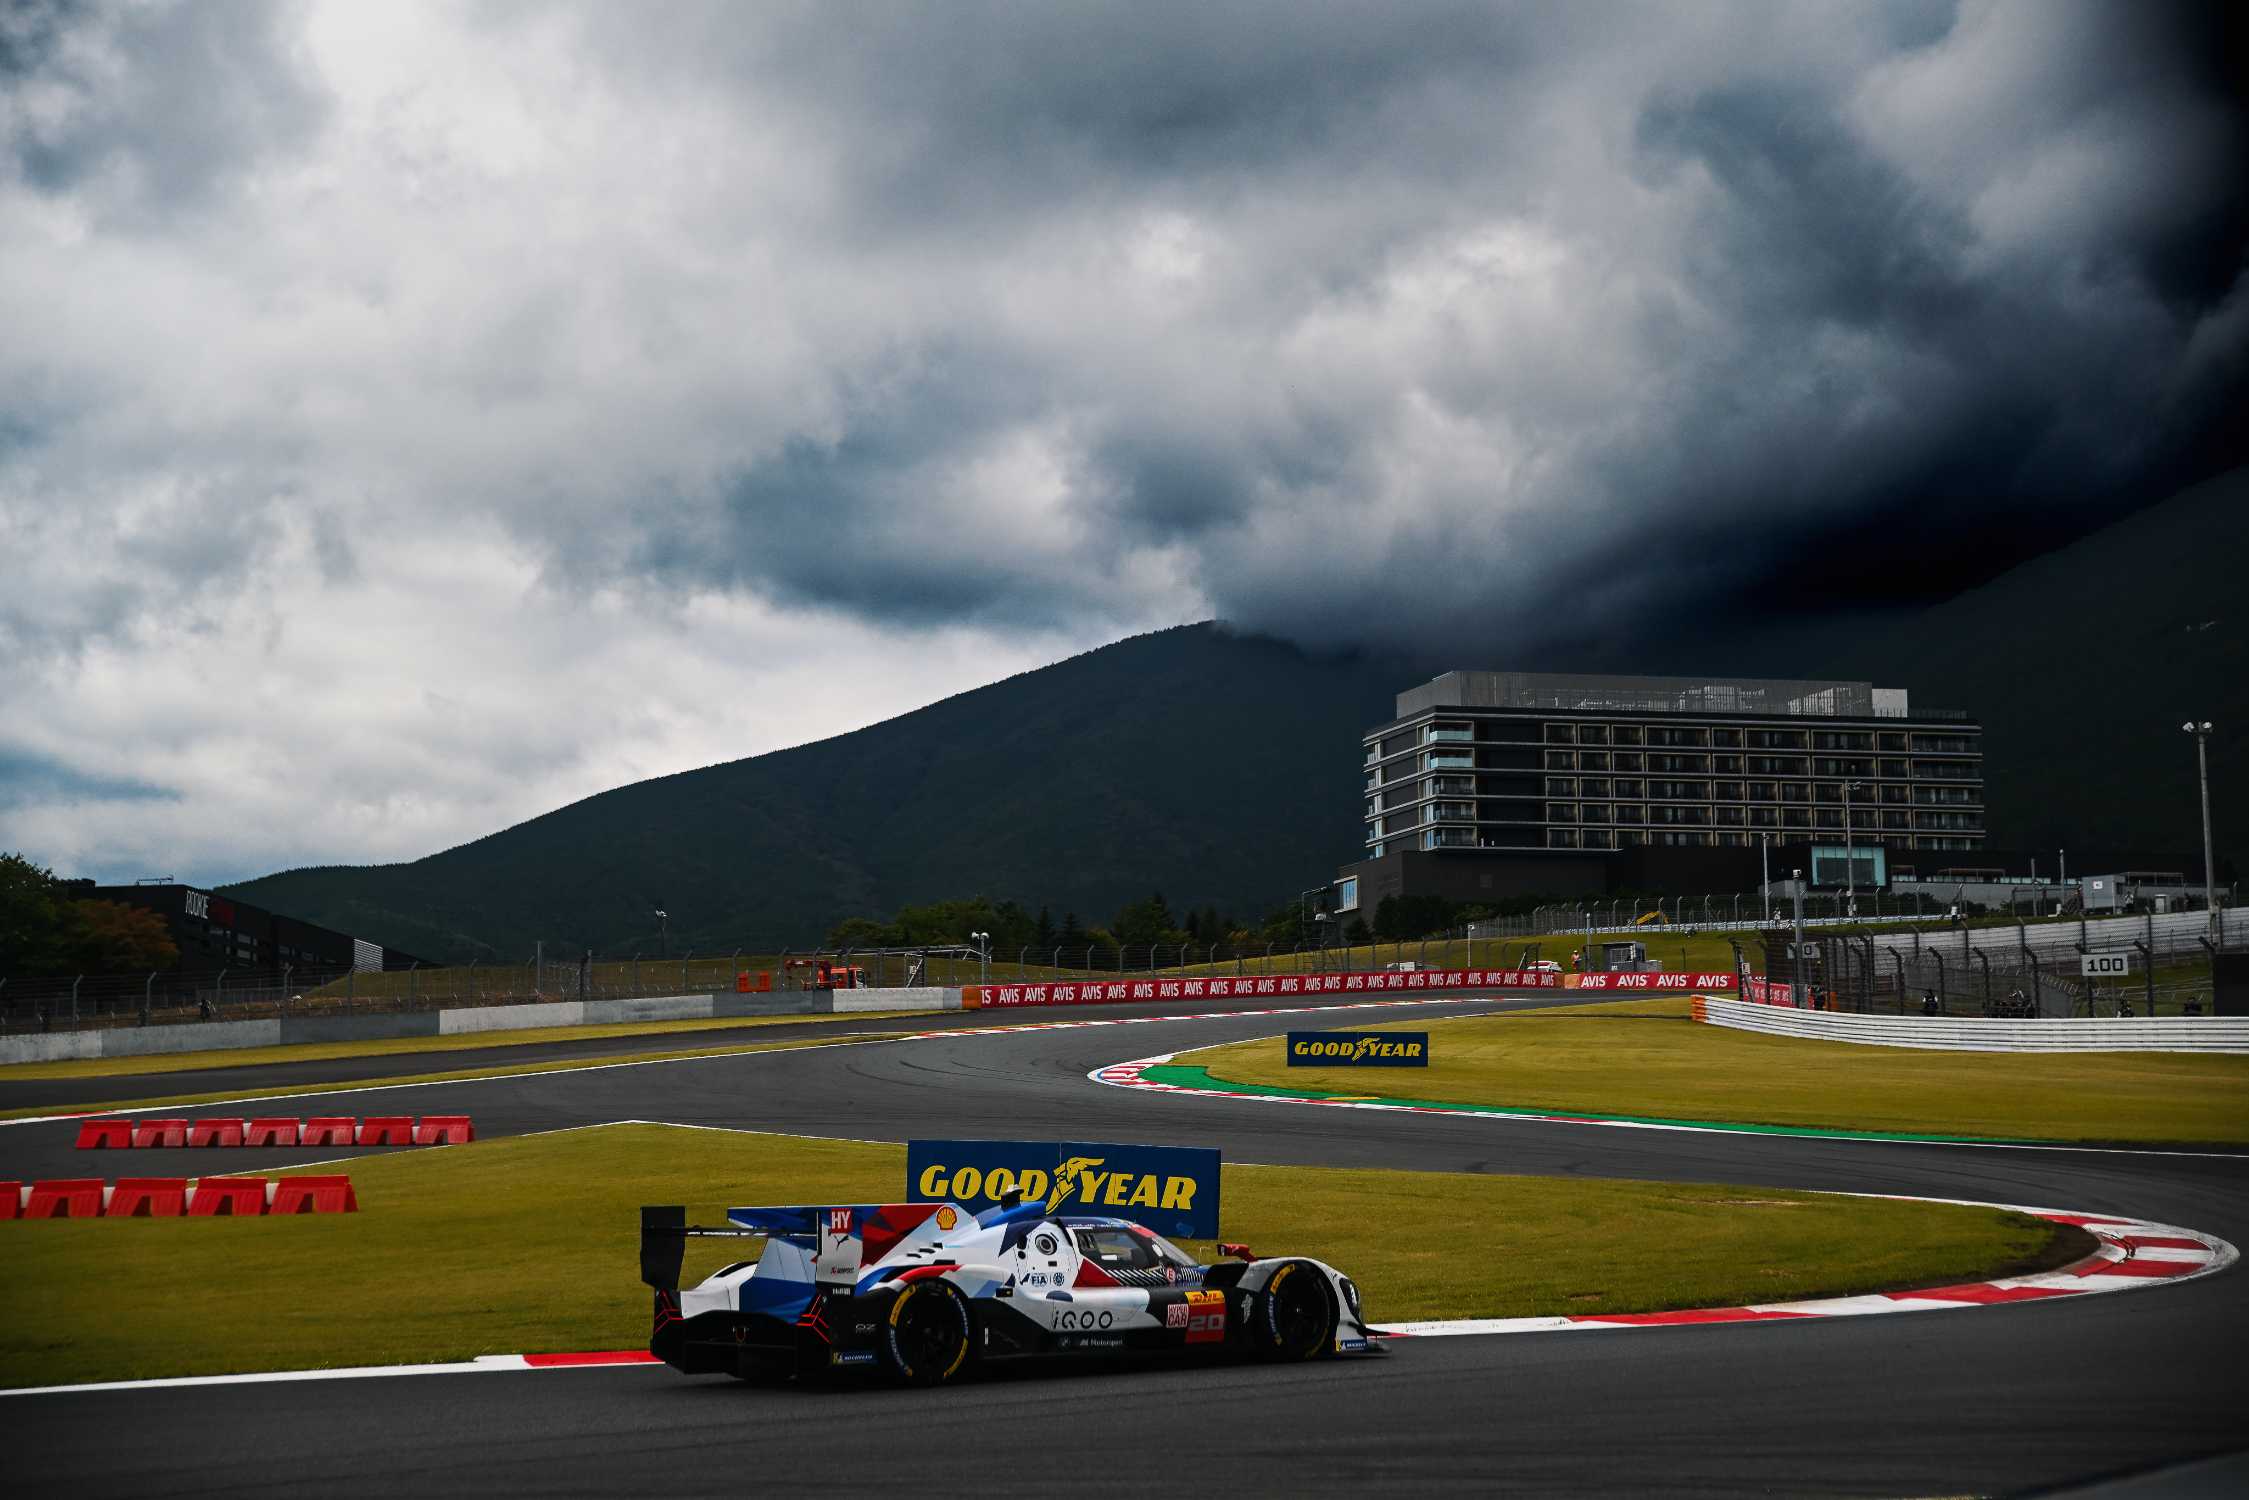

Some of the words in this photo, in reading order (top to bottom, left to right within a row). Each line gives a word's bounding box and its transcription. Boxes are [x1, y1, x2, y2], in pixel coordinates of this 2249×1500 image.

[2088, 958, 2123, 972] 100
[999, 989, 1019, 1003] AVIS
[1024, 988, 1046, 1001] AVIS
[1053, 986, 1075, 1001] AVIS
[1081, 985, 1102, 1000] AVIS
[1107, 985, 1126, 999] AVIS
[1134, 984, 1153, 998] AVIS
[1160, 983, 1179, 997] AVIS
[1184, 982, 1203, 995] AVIS
[1210, 981, 1228, 994] AVIS
[1235, 980, 1253, 994] AVIS
[1257, 979, 1275, 992] AVIS
[1281, 978, 1298, 991] AVIS
[1305, 977, 1320, 990] AVIS
[1324, 976, 1341, 989] AVIS
[1347, 976, 1363, 989] AVIS
[1368, 975, 1384, 988] AVIS
[1388, 975, 1403, 987] AVIS
[1408, 974, 1424, 986] AVIS
[1429, 973, 1444, 986] AVIS
[1446, 973, 1461, 985] AVIS
[1468, 972, 1481, 984] AVIS
[1486, 972, 1501, 984] AVIS
[1504, 972, 1518, 984] AVIS
[1523, 973, 1536, 985] AVIS
[1541, 974, 1554, 986] AVIS
[1581, 975, 1606, 987] AVIS
[1616, 975, 1648, 987] AVIS
[1657, 975, 1687, 987] AVIS
[1696, 975, 1728, 987] AVIS
[831, 1210, 850, 1229] HY
[1168, 1313, 1187, 1326] CAR
[1190, 1314, 1225, 1332] 20
